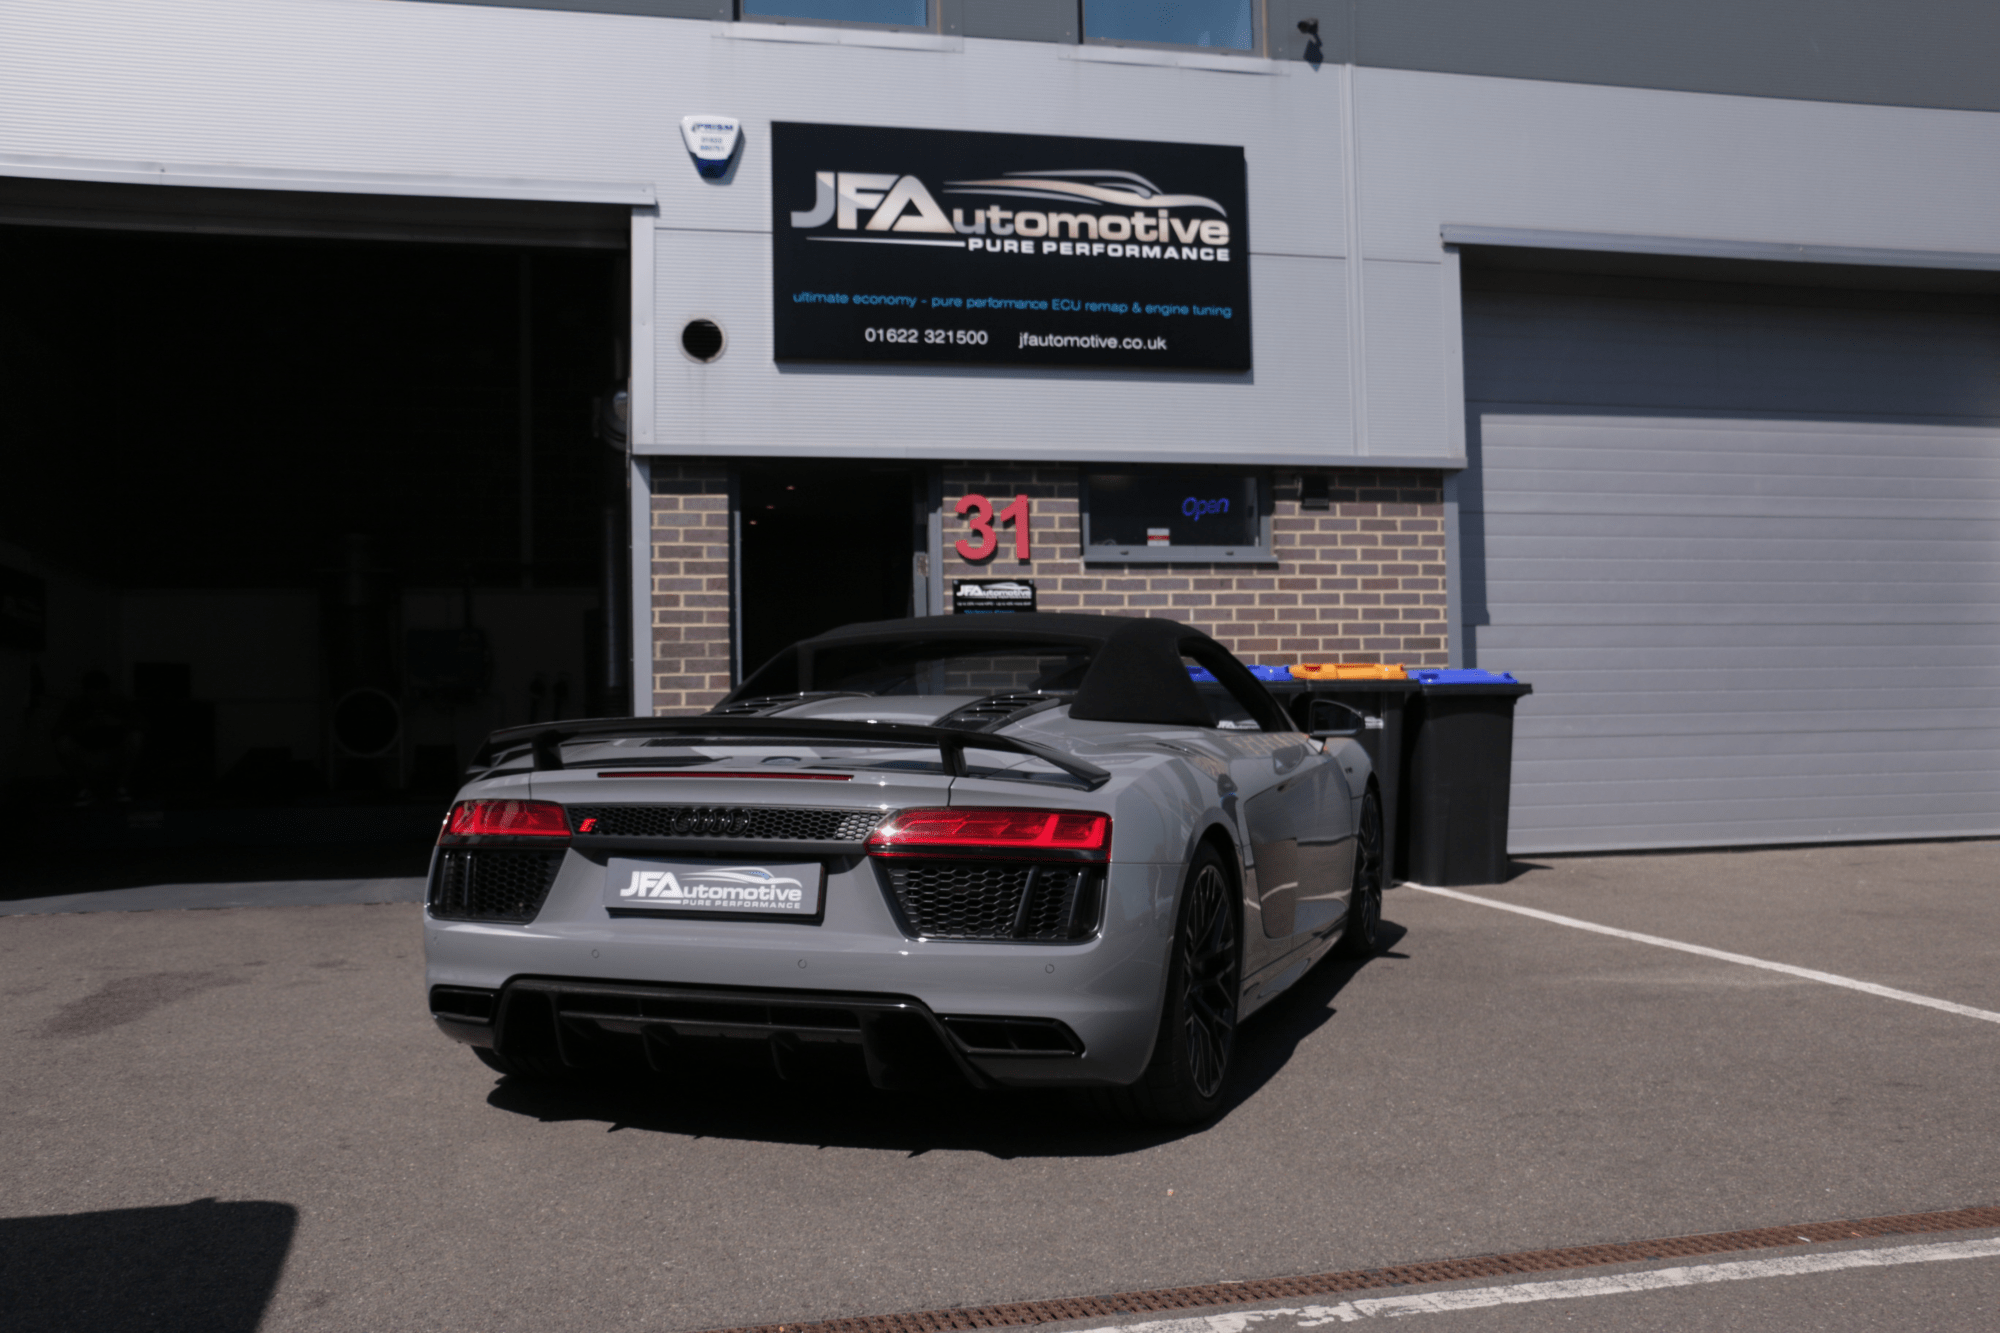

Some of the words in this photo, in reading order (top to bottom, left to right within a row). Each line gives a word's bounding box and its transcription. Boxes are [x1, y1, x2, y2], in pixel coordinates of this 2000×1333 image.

[790, 171, 1230, 245] JFAutomotive
[967, 238, 1035, 255] PURE
[1042, 242, 1231, 262] PERFORMANCE
[793, 291, 849, 304] ultimate
[852, 294, 917, 308] economy
[931, 297, 963, 309] pure
[966, 296, 1048, 311] performance
[1052, 298, 1081, 311] ECU
[1084, 302, 1128, 315] remap
[1131, 302, 1142, 314] &
[1145, 302, 1189, 317] engine
[1192, 304, 1232, 319] tuning
[864, 327, 919, 344] 01622
[924, 329, 989, 345] 321500
[1018, 331, 1167, 351] jfautomotive.co.uk
[1182, 496, 1230, 522] Open
[954, 493, 1030, 560] 31
[619, 871, 802, 901] JFAutomotive
[682, 899, 709, 907] PURE
[714, 900, 801, 909] PERFORMANCE
